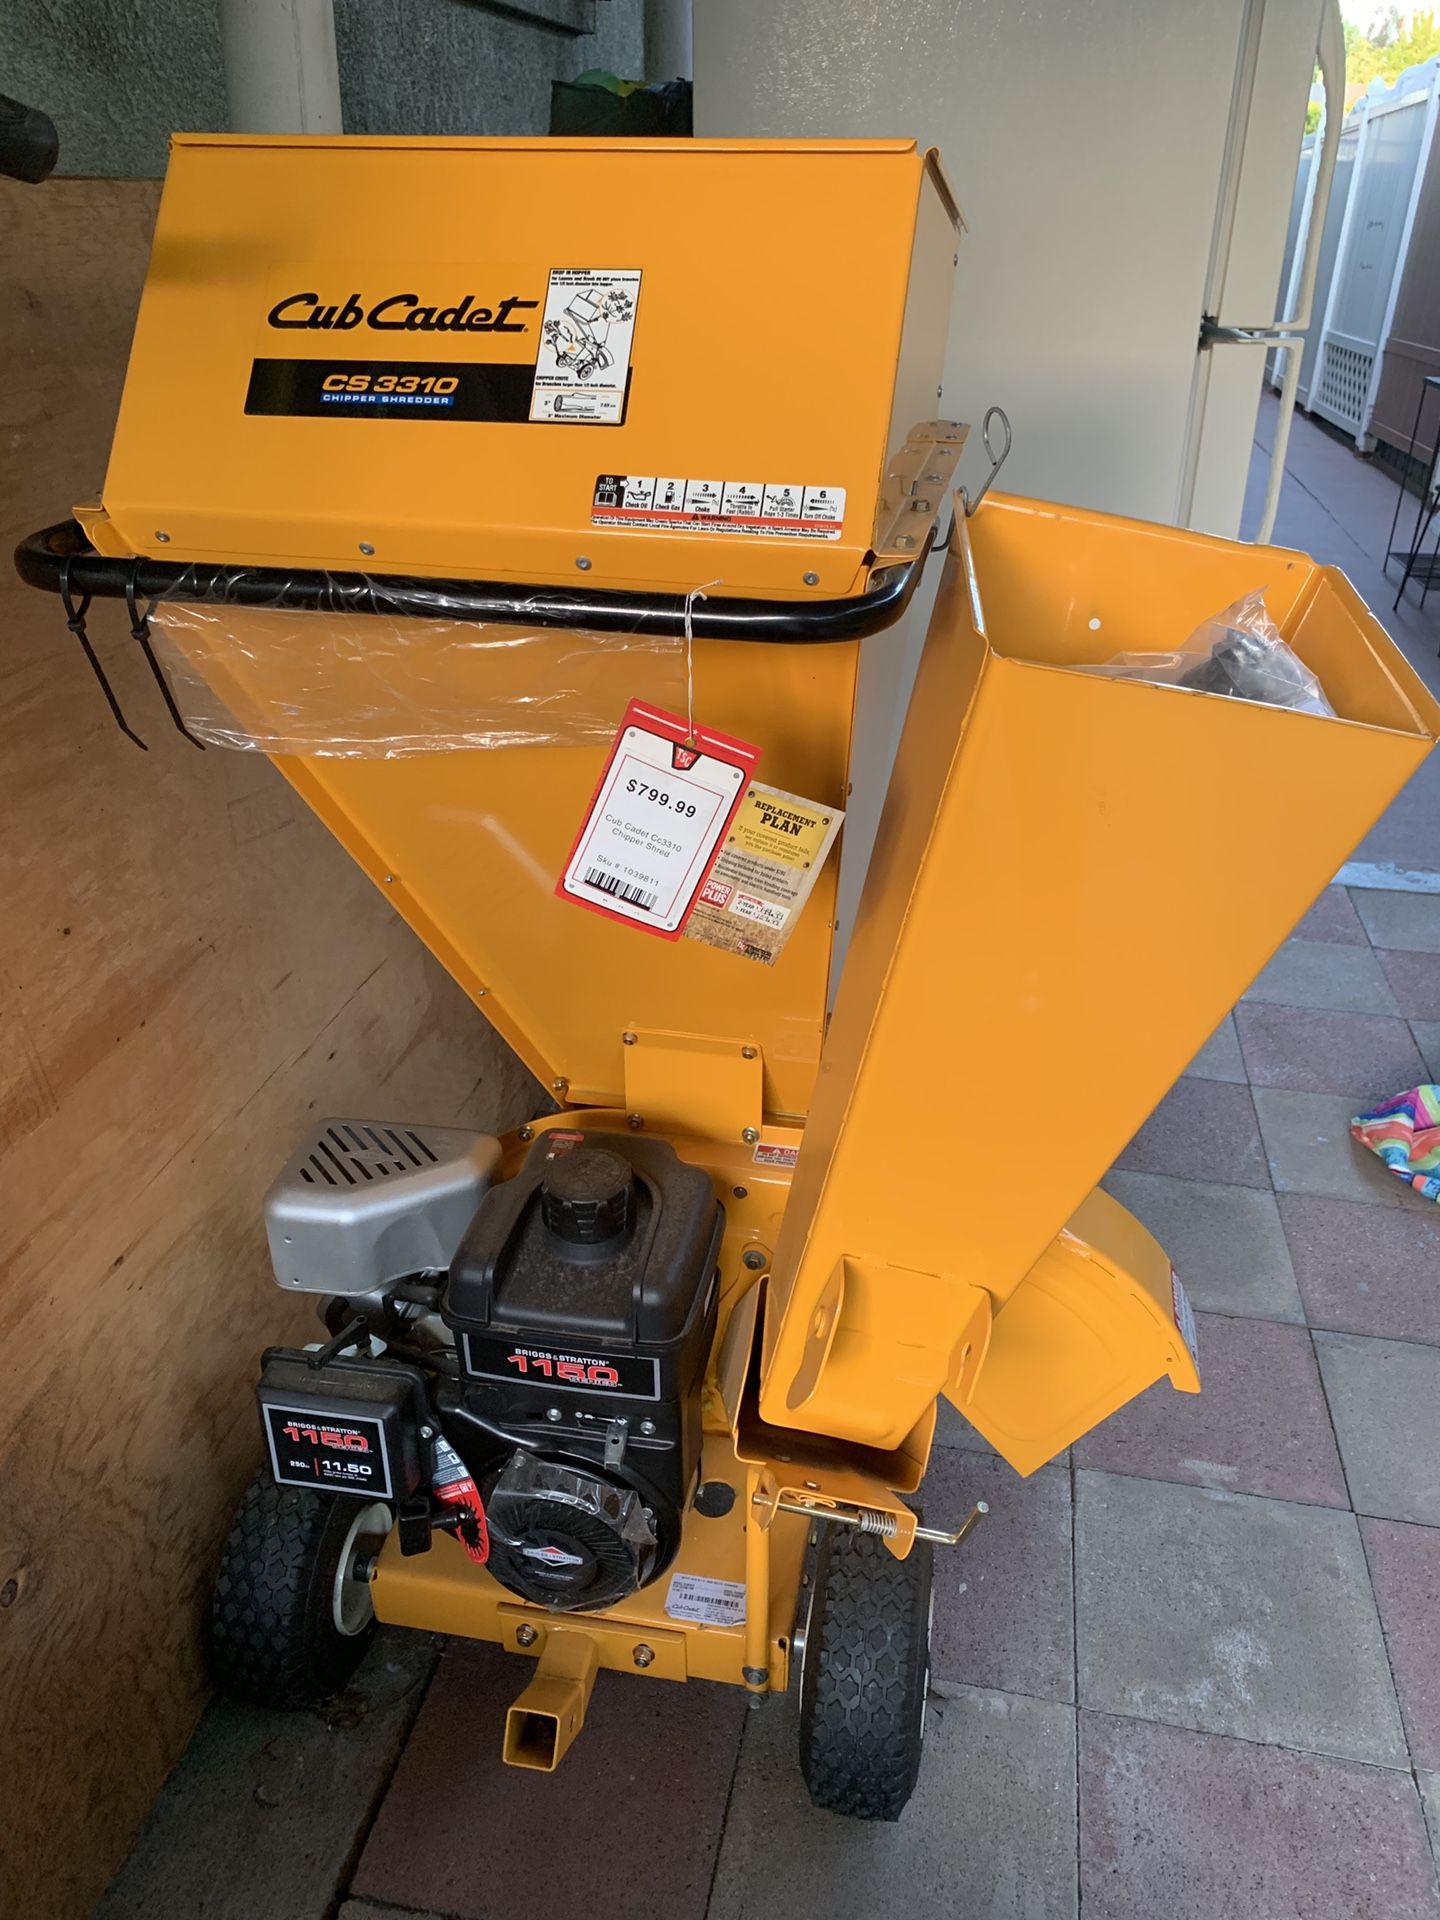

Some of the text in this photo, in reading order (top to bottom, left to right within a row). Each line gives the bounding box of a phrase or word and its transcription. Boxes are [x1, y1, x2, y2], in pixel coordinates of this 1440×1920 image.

[268, 293, 539, 332] Cub Cadet
[322, 374, 459, 394] CS 3310
[323, 394, 449, 404] CHIPPER SHREDDER
[605, 477, 614, 485] TO
[638, 480, 642, 488] 1
[667, 482, 674, 490] 2
[702, 484, 709, 492] 3
[739, 486, 746, 494] 4
[783, 488, 790, 497] 5
[819, 490, 827, 499] 6
[676, 749, 692, 767] TSC
[626, 779, 697, 818] $799.99
[754, 800, 817, 828] REPLACEMENT
[760, 812, 803, 836] PLAN
[605, 814, 682, 853] Cub Cadet Cc3310
[611, 827, 671, 858] Chipper Shred
[596, 854, 612, 867] Sku
[623, 866, 660, 887] 1039811
[706, 879, 732, 895] POWER
[702, 888, 727, 905] PLUS
[507, 1355, 619, 1384] 1150
[282, 1427, 369, 1450] 1150
[322, 1460, 372, 1476] 11.50
